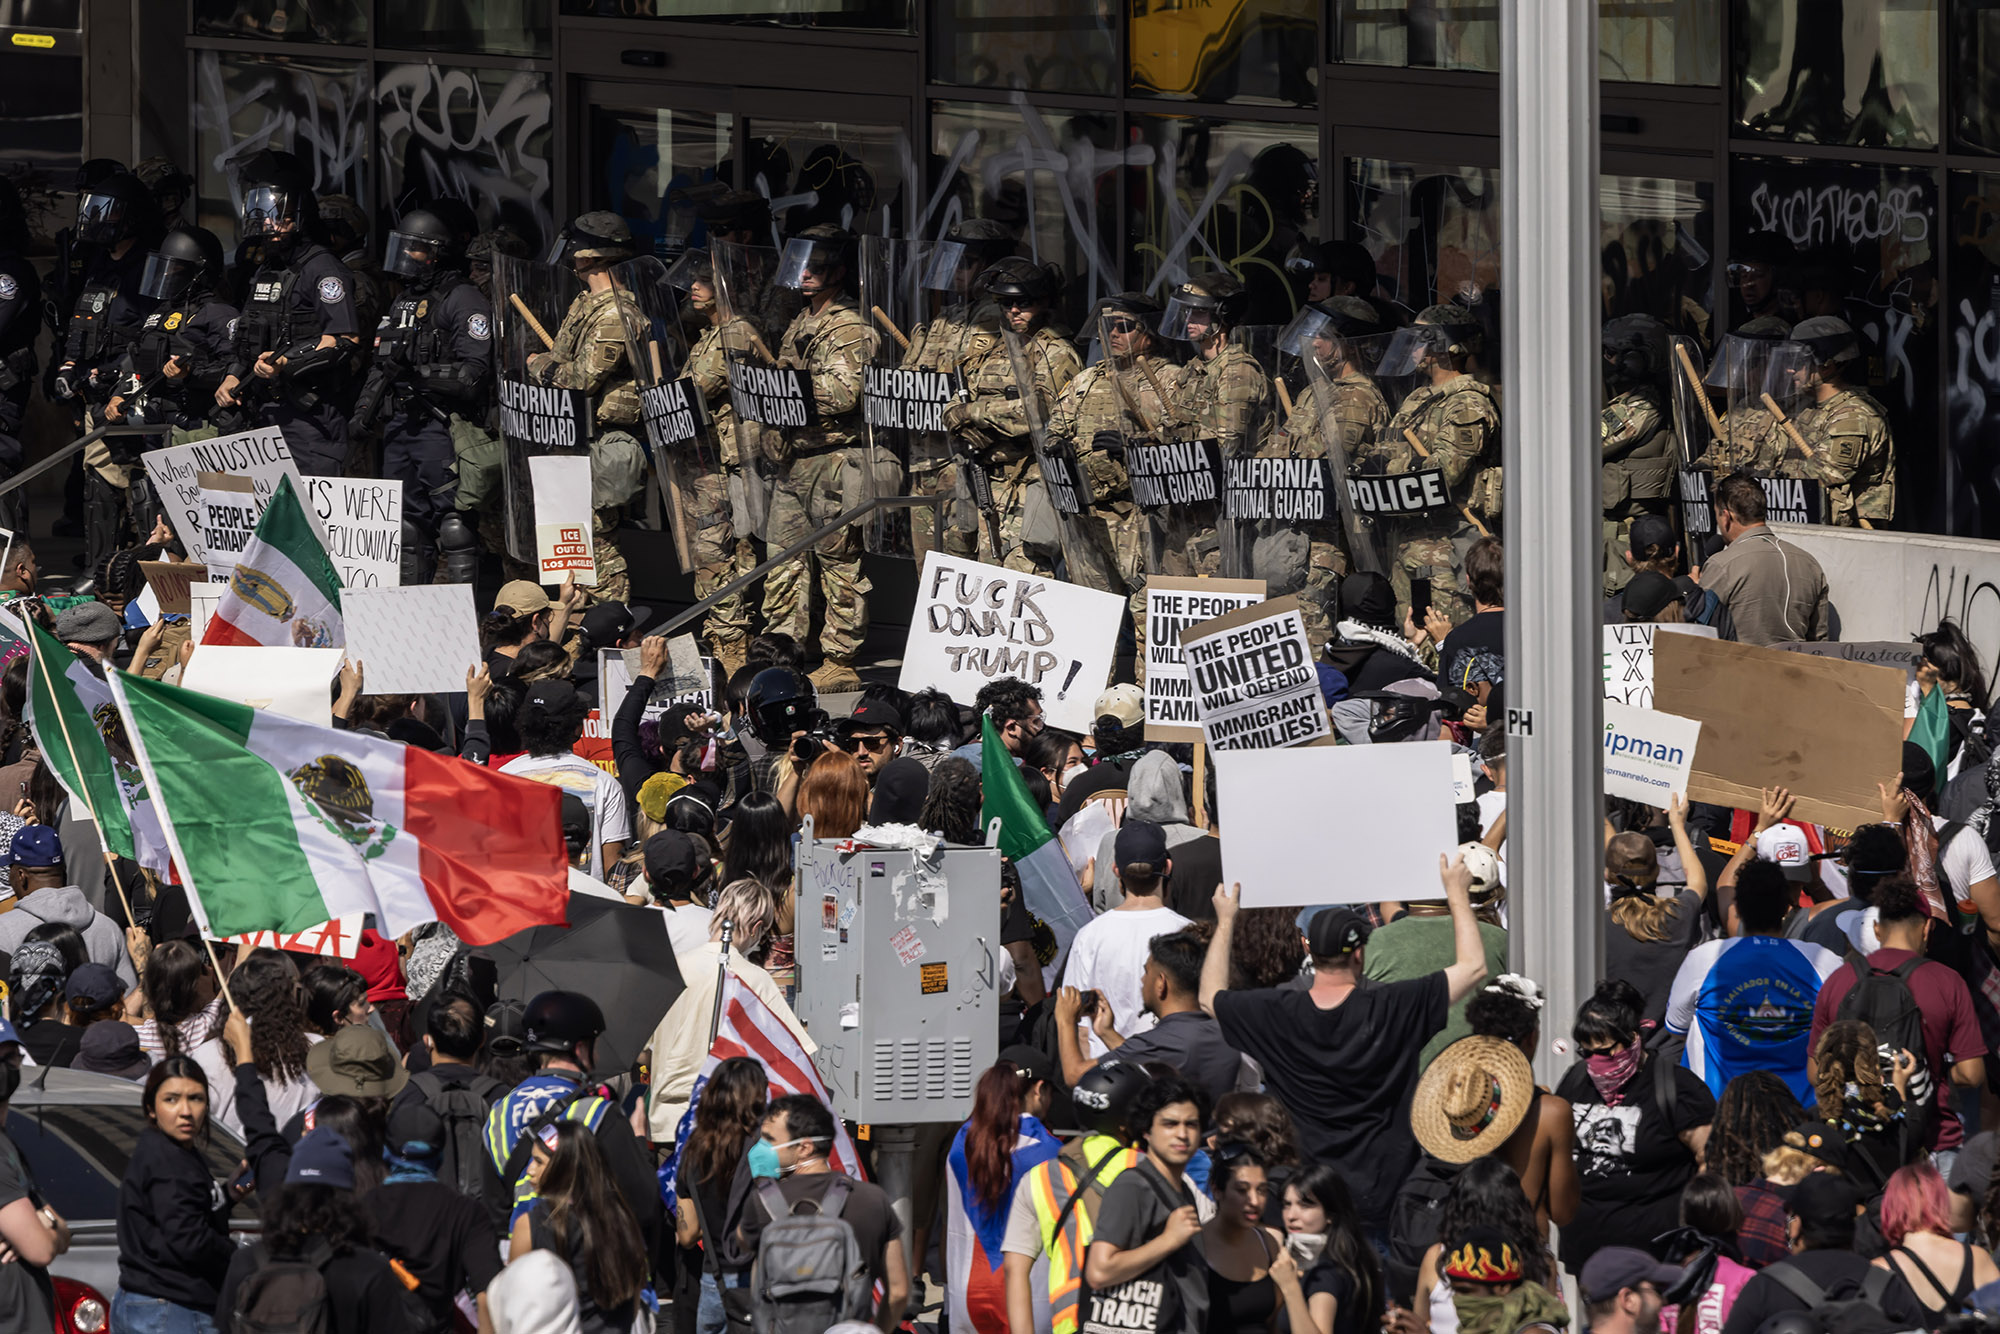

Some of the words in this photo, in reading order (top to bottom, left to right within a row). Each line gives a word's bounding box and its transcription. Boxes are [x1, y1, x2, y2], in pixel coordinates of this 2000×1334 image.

[500, 380, 575, 418] ALIFORNIA
[763, 398, 807, 427] GUARD
[906, 400, 948, 432] GUAR
[533, 414, 576, 447] GUARD
[659, 409, 696, 446] GUARD
[147, 455, 198, 486] When
[191, 436, 292, 473] INJUSTICE
[1227, 458, 1324, 489] CALIFORNIA
[343, 485, 400, 523] WERE
[1168, 470, 1216, 505] GUARD
[1274, 489, 1324, 520] GUARD
[1345, 472, 1446, 512] POLICE
[207, 504, 256, 531] PEOPLE
[555, 545, 575, 554] OUT
[576, 545, 585, 554] OF
[563, 530, 579, 541] ICE
[543, 560, 565, 569] LOS
[566, 559, 593, 567] ANGELES
[930, 566, 1048, 624] FUCK
[1152, 595, 1183, 615] THE
[927, 603, 1055, 647] DONALD
[1189, 638, 1222, 665] THE
[1227, 616, 1298, 653] PEOPLE
[1612, 624, 1661, 645] VIV
[1194, 638, 1304, 694] UNITED
[1202, 687, 1244, 711] WILL
[1245, 666, 1310, 699] DEFEND
[1208, 694, 1317, 742] IMMIGRANT
[1508, 709, 1533, 736] PH
[1604, 723, 1684, 765] ipman
[1604, 766, 1671, 789] ipmanrelo.com
[1089, 1296, 1159, 1331] TRADE
